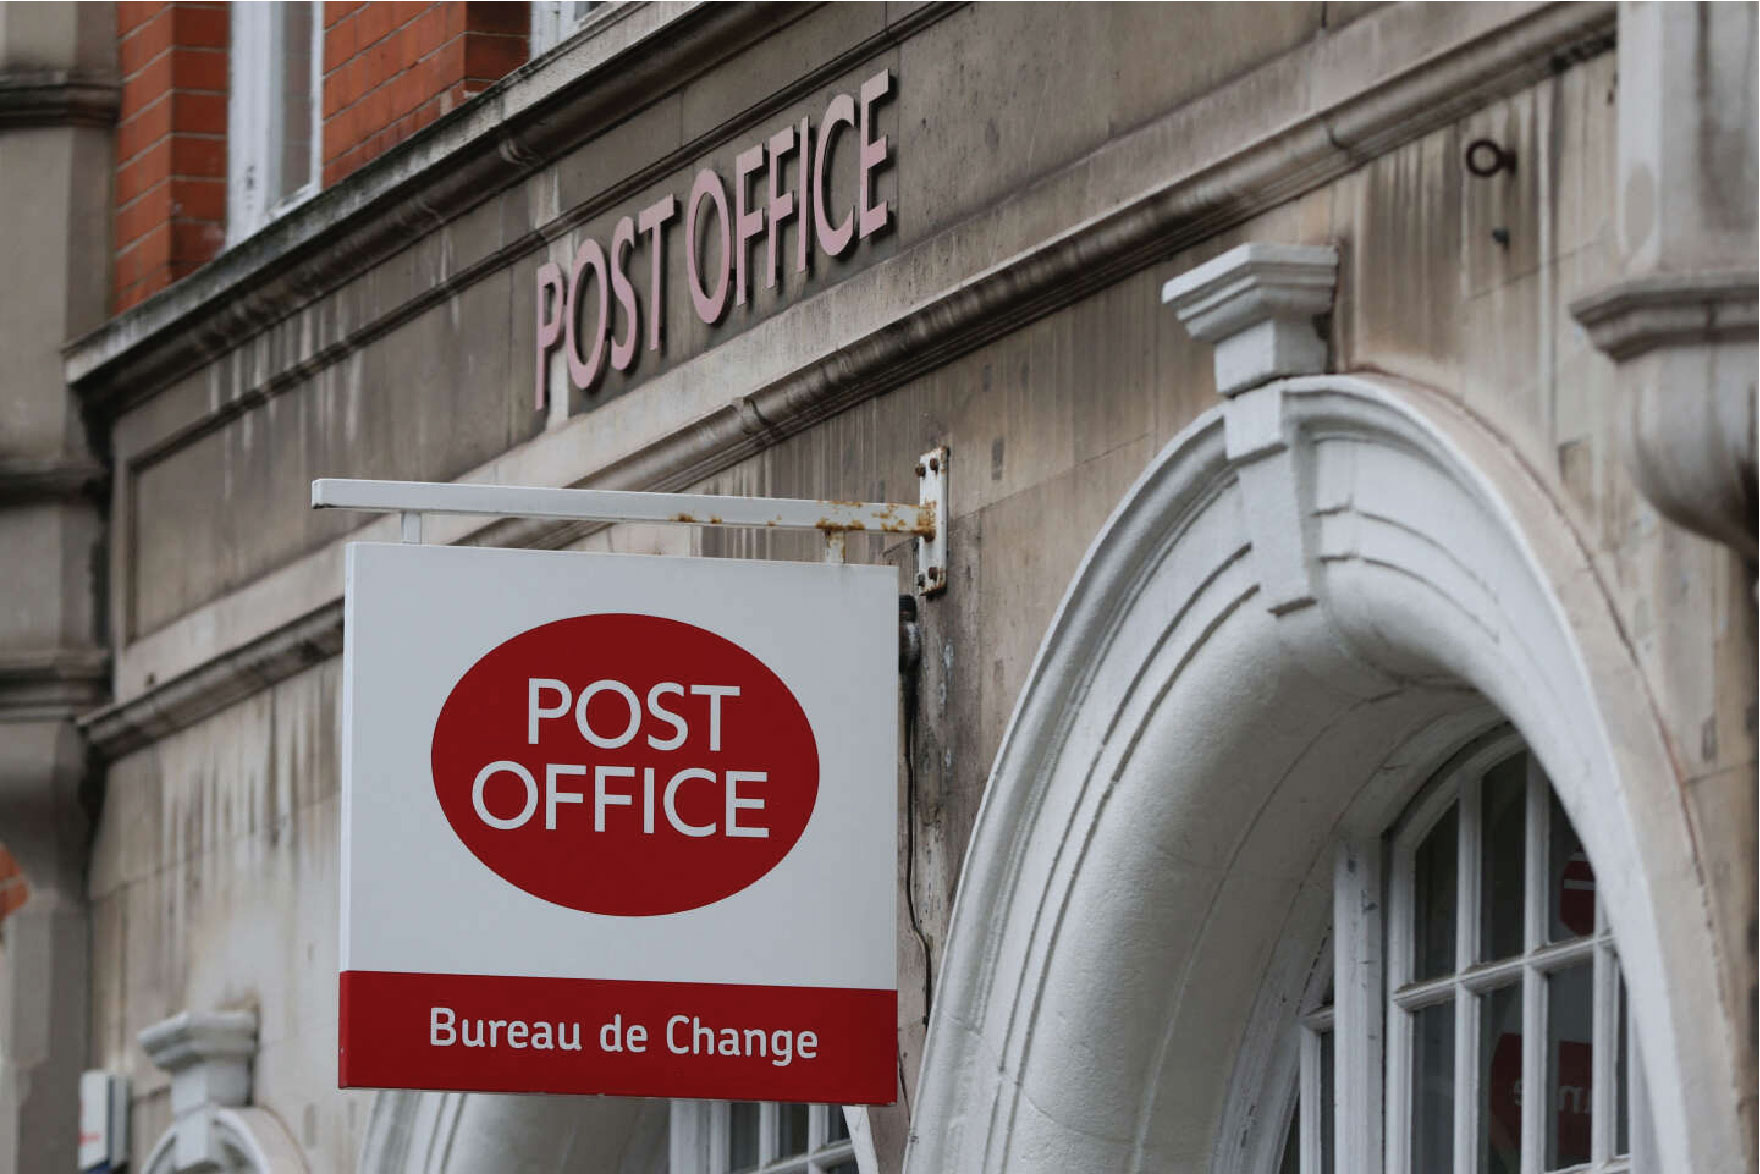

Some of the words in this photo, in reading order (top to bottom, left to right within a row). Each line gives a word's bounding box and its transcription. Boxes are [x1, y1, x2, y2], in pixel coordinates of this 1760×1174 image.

[535, 193, 675, 411] POST
[686, 68, 890, 325] OFFICE
[528, 677, 741, 752] POST
[471, 760, 770, 838] OFFICE
[430, 1007, 583, 1052] Bureau
[599, 1013, 649, 1053] de
[666, 1014, 818, 1067] Change
